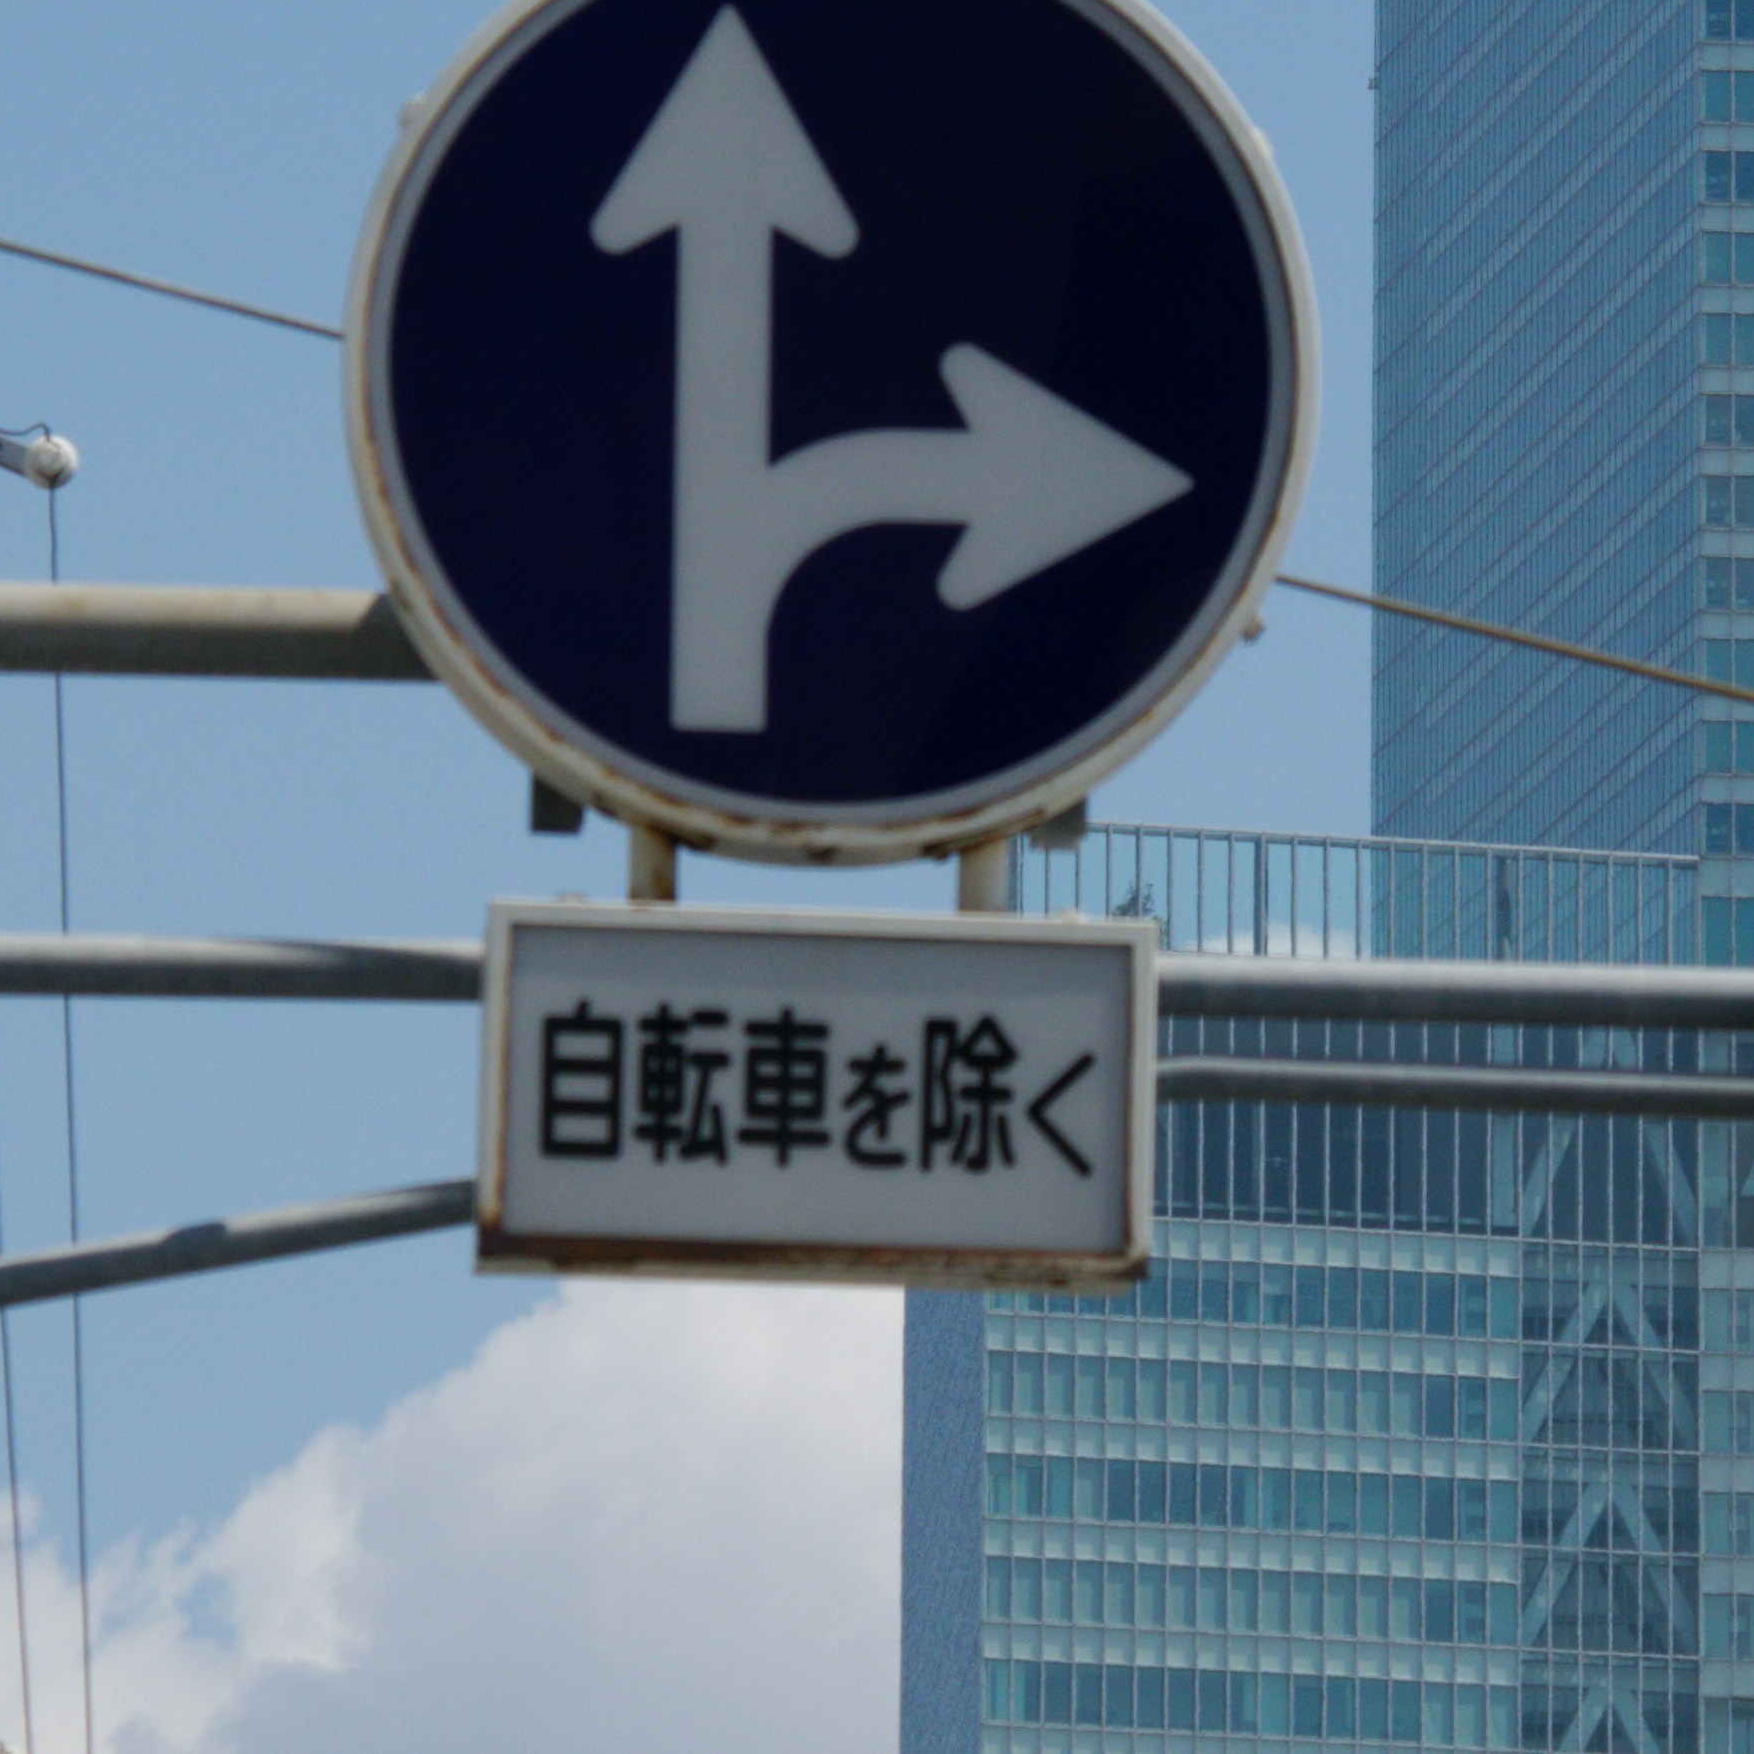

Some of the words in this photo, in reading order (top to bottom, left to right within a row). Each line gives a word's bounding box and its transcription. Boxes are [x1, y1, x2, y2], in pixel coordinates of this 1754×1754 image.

[539, 998, 1096, 1178] 自転車を除く
